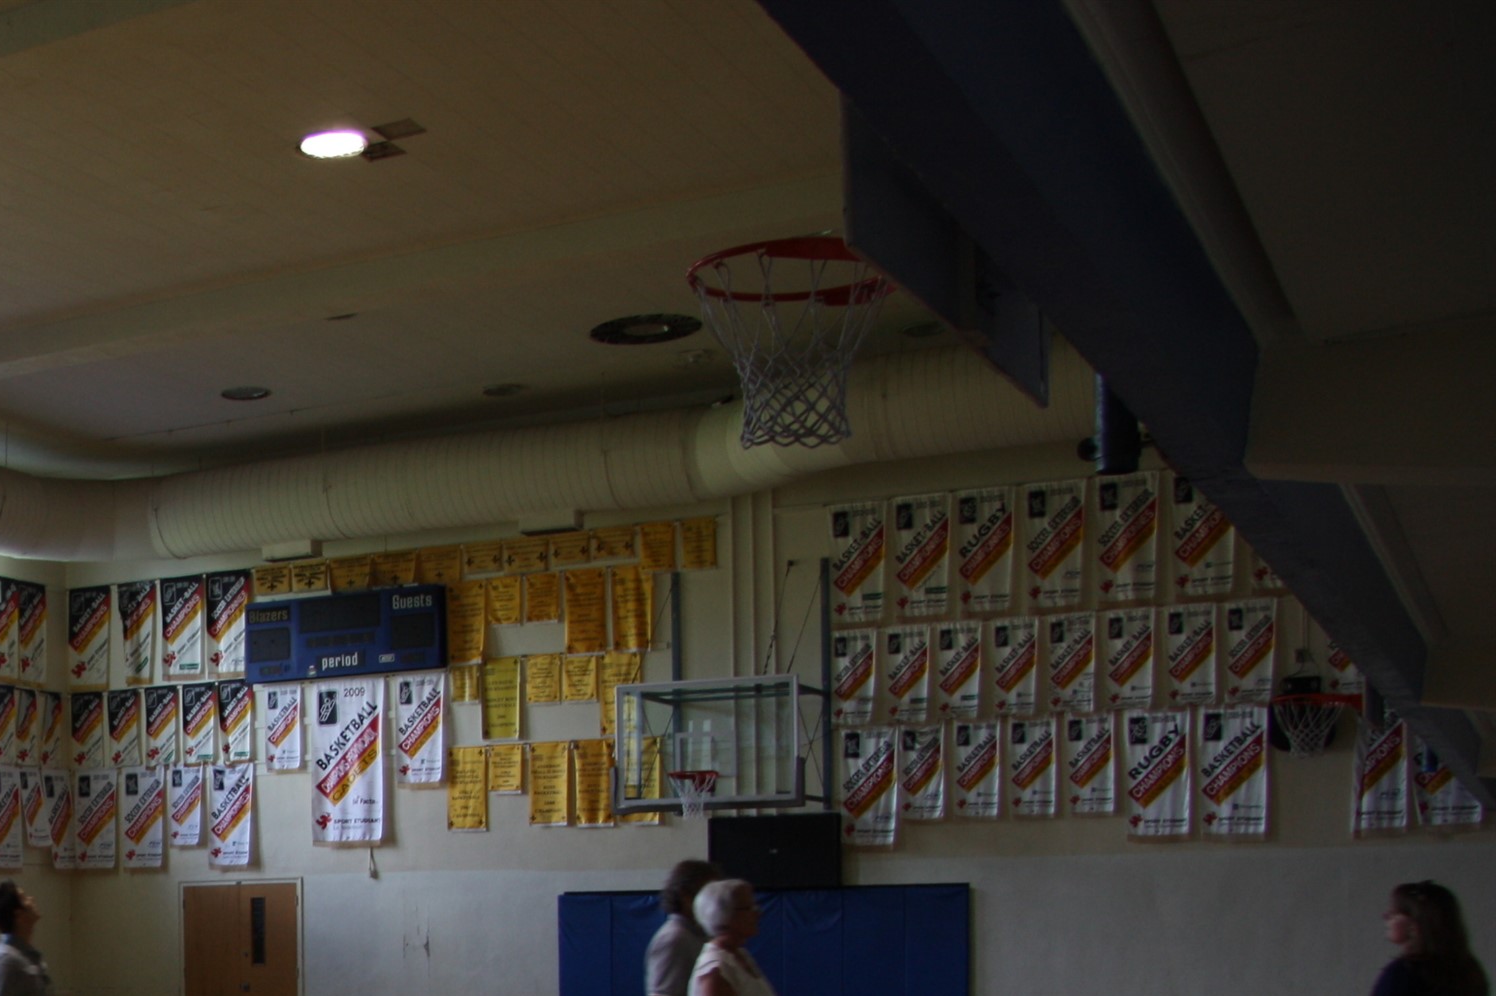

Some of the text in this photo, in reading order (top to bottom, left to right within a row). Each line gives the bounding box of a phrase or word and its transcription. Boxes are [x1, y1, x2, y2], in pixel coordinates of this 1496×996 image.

[959, 502, 1007, 557] RUGBY
[1031, 517, 1082, 570] CHAMPIONS
[837, 538, 882, 588] CHAMPIONS
[165, 593, 201, 638] CHAMPIONS
[249, 609, 288, 623] Blazers
[392, 595, 433, 611] Guests
[73, 604, 108, 646] CHAMPIONS
[321, 652, 359, 672] period
[224, 696, 250, 730] HAMPIONS
[344, 686, 366, 698] 2009
[398, 687, 441, 736] BASKETBALL
[184, 699, 214, 735] CHAMPIONS
[267, 696, 297, 732] BASKETBALL
[269, 709, 298, 743] CHAMPIONS
[401, 706, 441, 751] CHAMPIONS
[316, 701, 379, 770] BASKETBALL
[956, 732, 995, 773] BASKETBALL
[1012, 730, 1052, 771] BASKETBALL
[1069, 727, 1110, 769] BASKETBALL
[1128, 724, 1180, 780] RUGBY
[1202, 721, 1261, 778] BASKETBALL
[333, 748, 378, 802] CADETS
[847, 760, 894, 810] CHAMPIONS
[1132, 744, 1184, 798] CHAMPIONS
[1206, 742, 1262, 796] CHAMPIONS
[127, 797, 163, 838] CHAMPIONS
[173, 788, 201, 818] CHAMPIONS
[212, 774, 250, 820] BASKETBALL
[78, 799, 114, 838] CHAMPIONS
